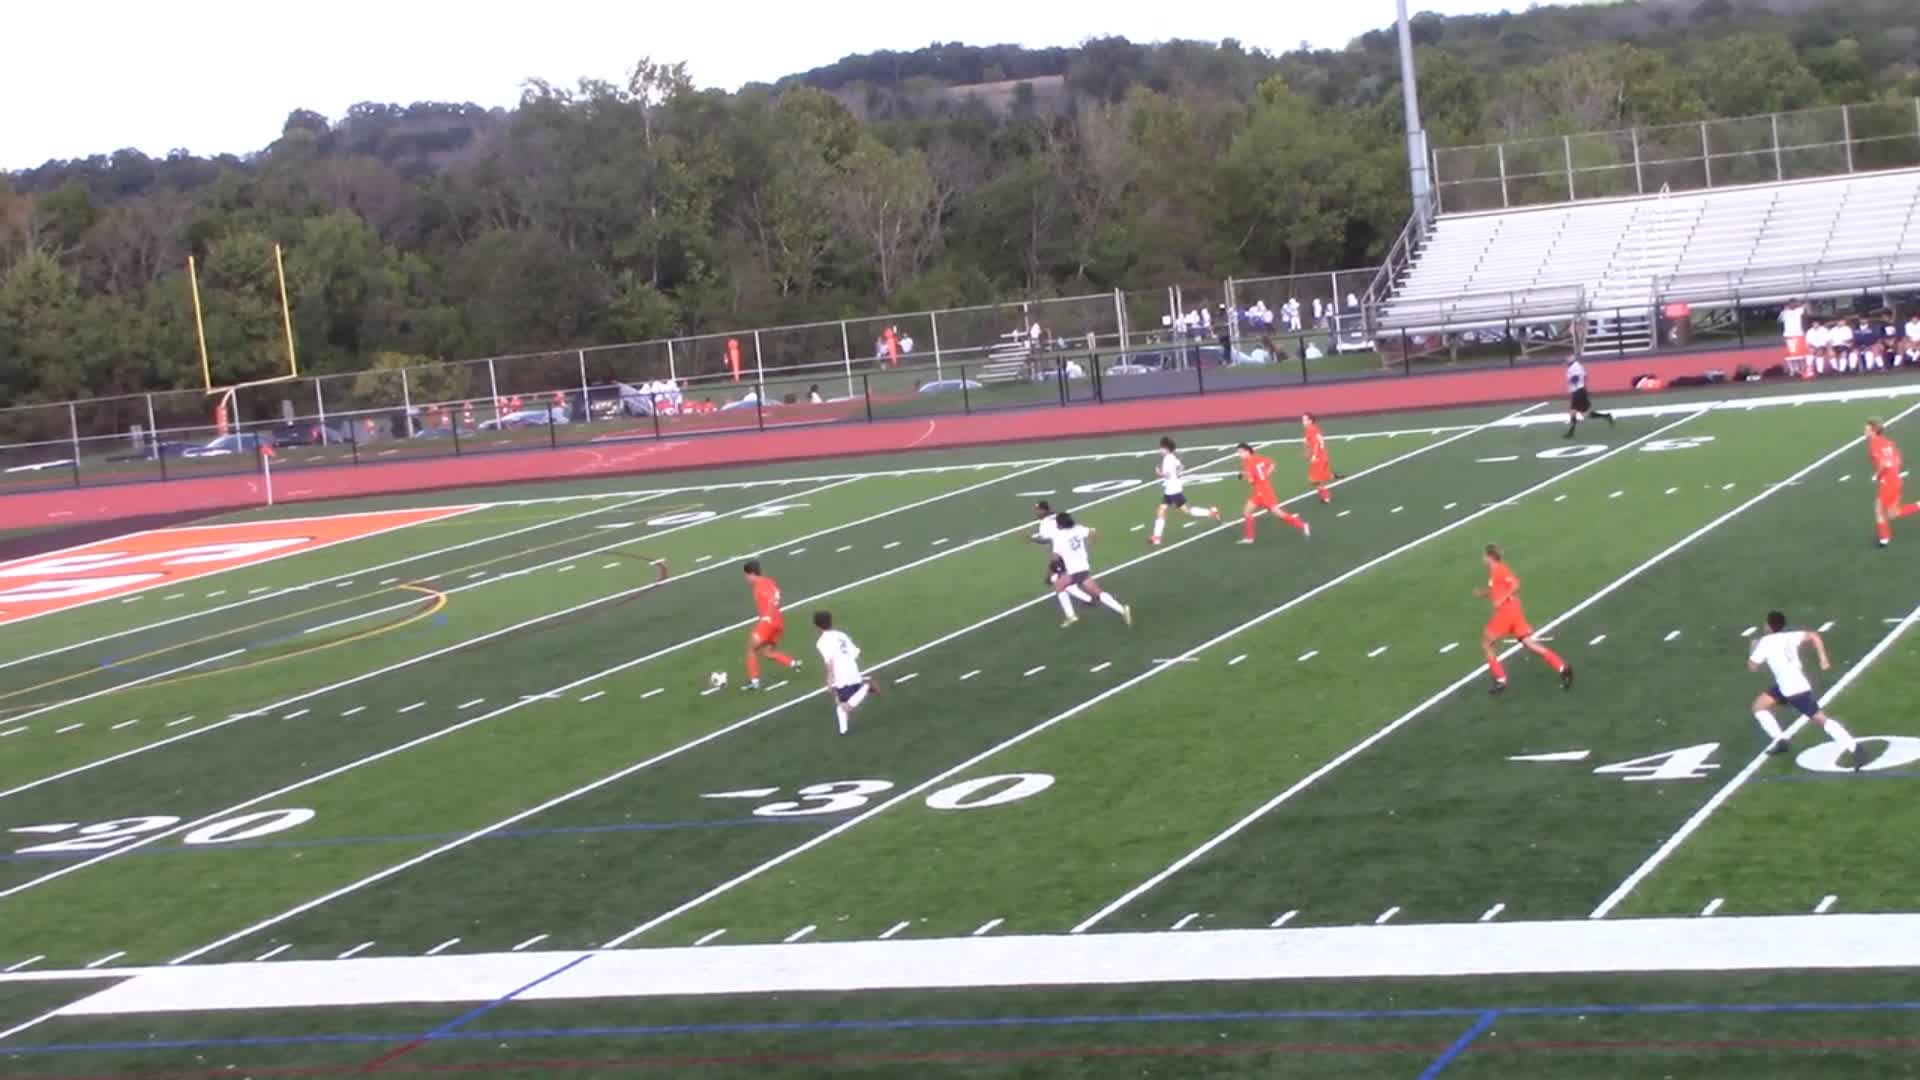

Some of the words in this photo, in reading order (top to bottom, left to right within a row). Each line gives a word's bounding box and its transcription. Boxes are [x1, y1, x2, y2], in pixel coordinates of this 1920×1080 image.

[1593, 736, 1920, 781] 40
[752, 773, 1056, 816] 30
[14, 808, 316, 854] 20
